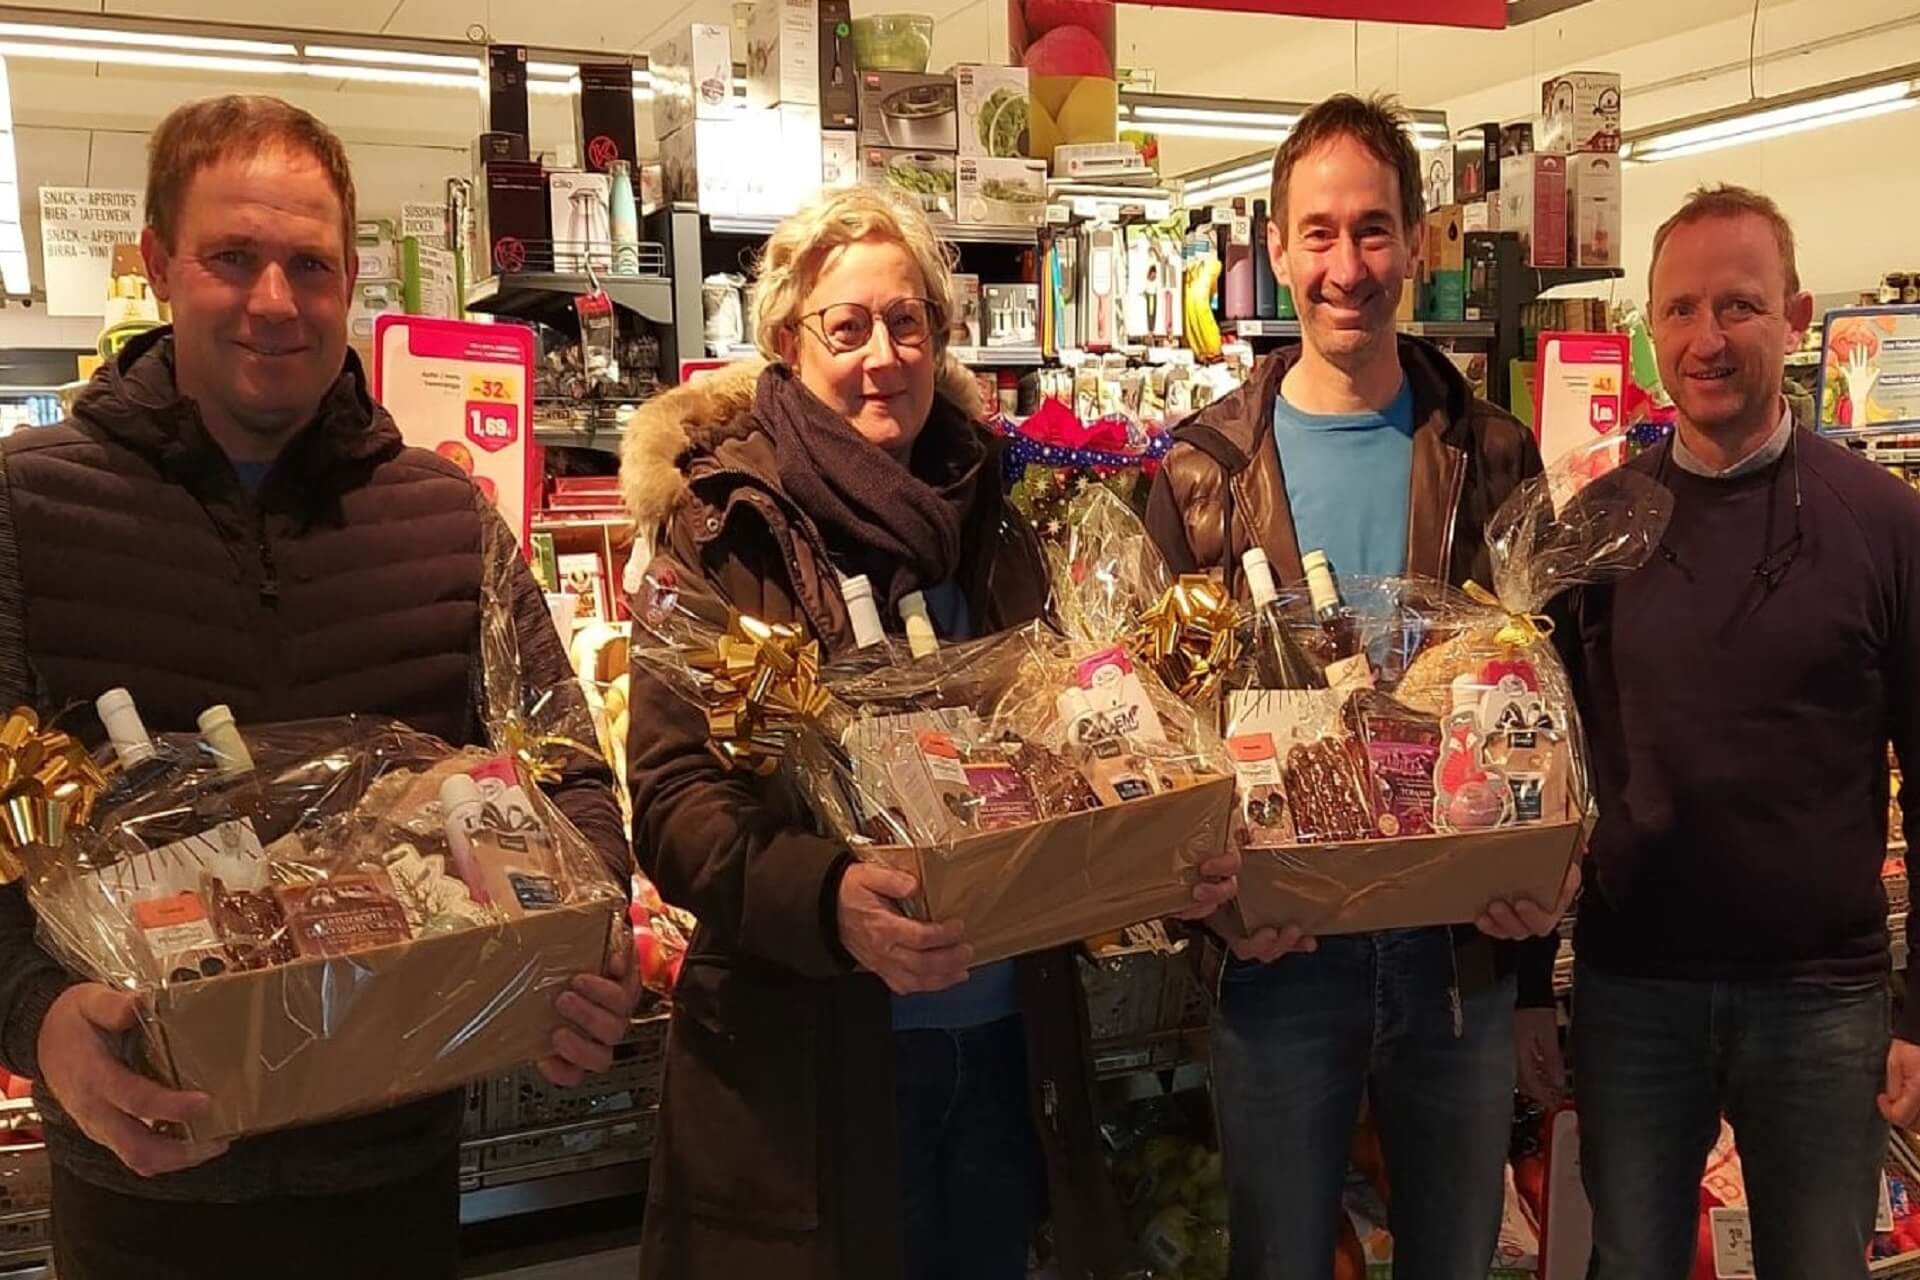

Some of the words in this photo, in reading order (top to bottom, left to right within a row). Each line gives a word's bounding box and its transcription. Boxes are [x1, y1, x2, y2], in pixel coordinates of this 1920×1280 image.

[44, 192, 78, 205] SNACK
[44, 207, 68, 220] BIER
[79, 208, 132, 221] TAFELWEIN
[46, 229, 80, 242] SNACK
